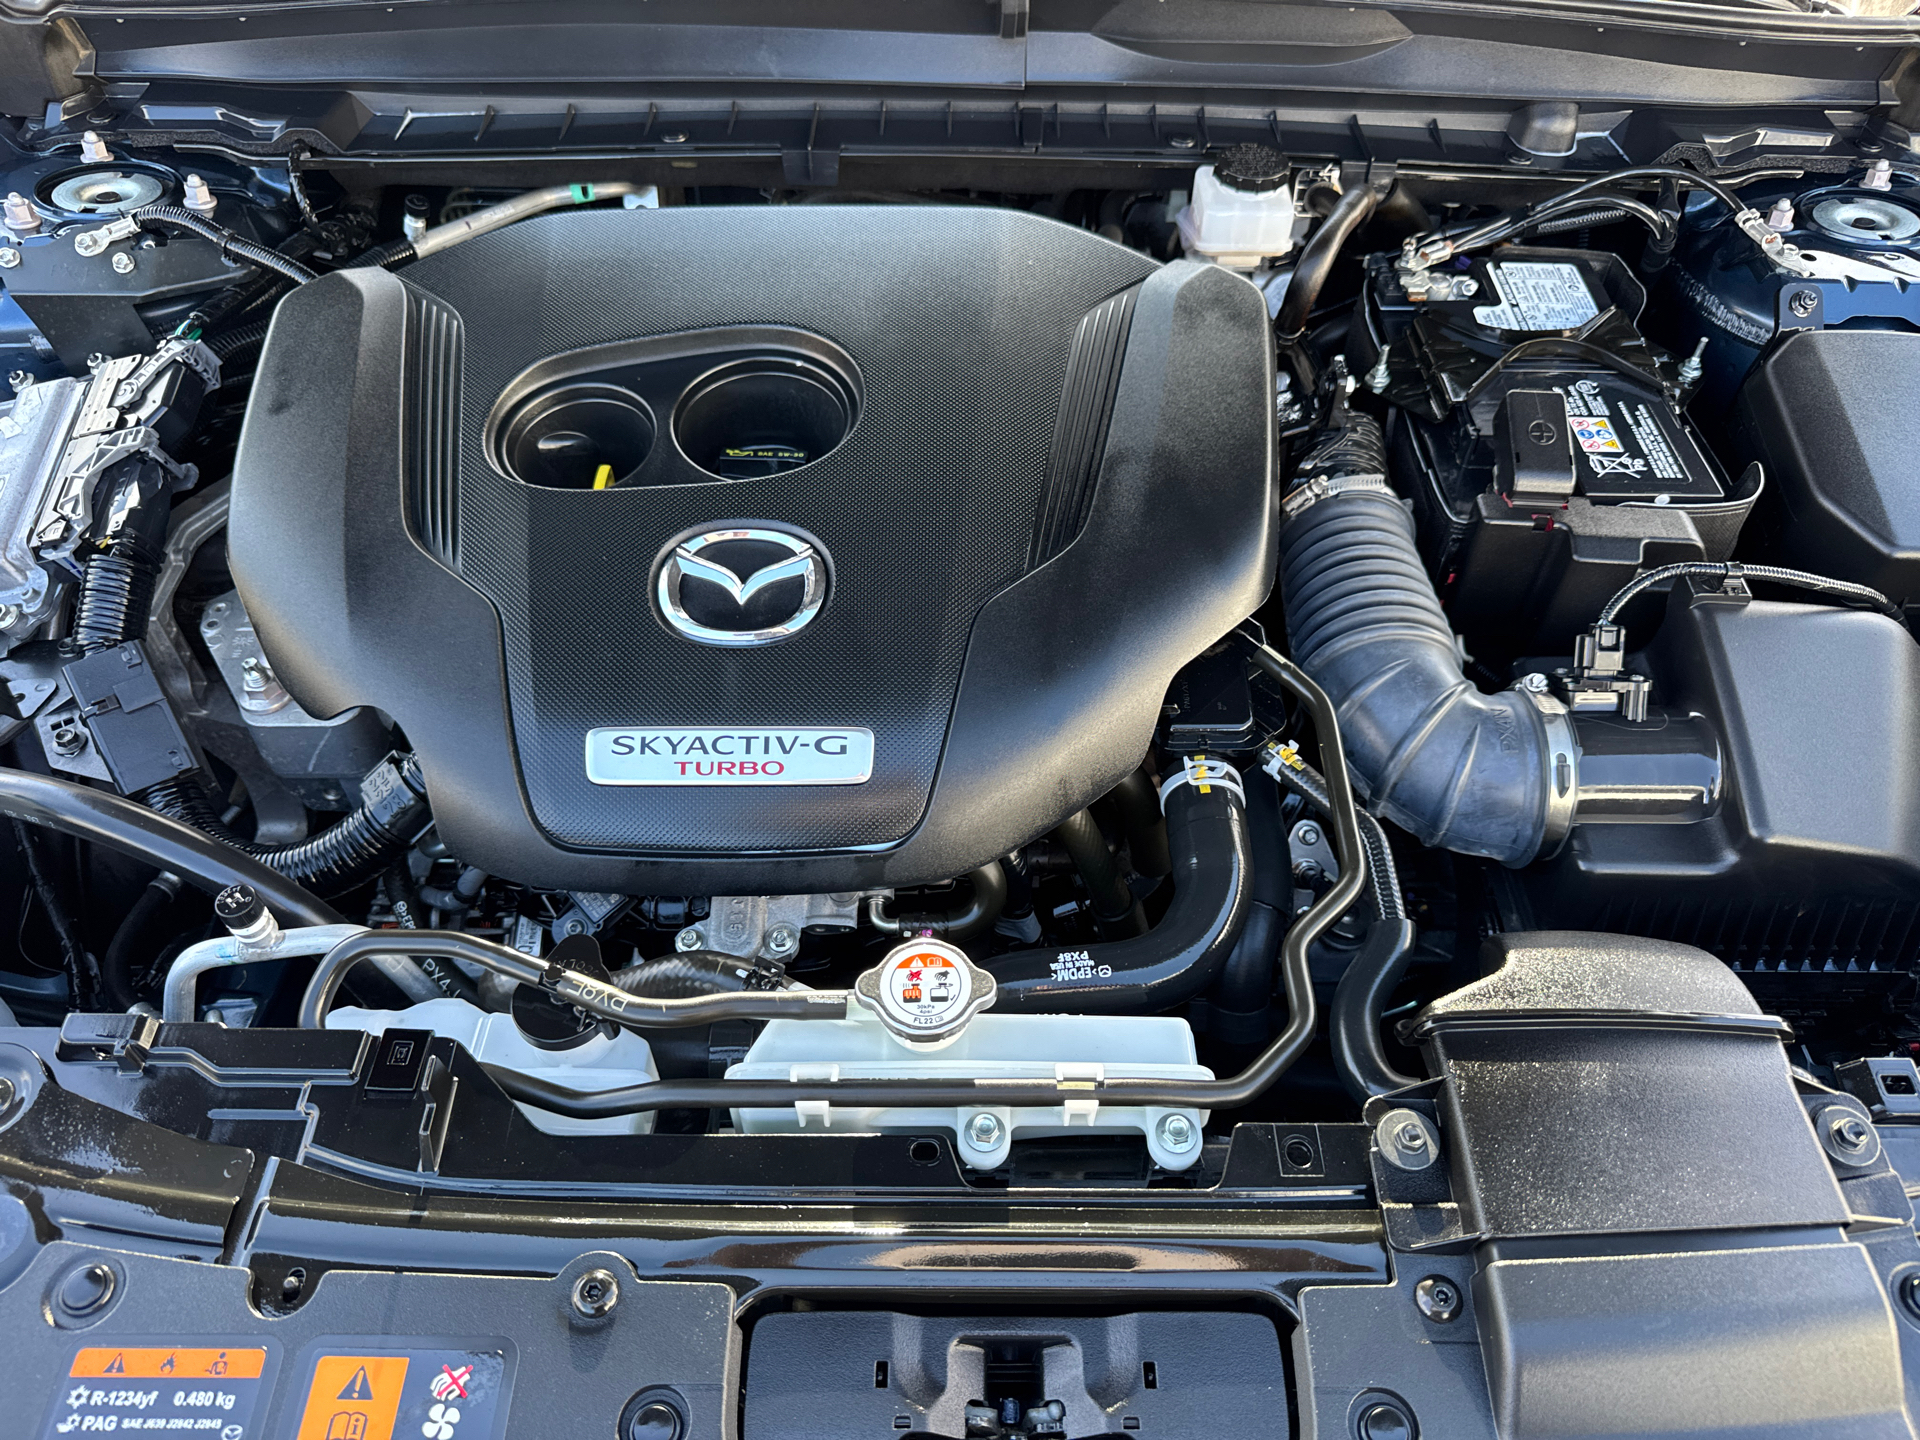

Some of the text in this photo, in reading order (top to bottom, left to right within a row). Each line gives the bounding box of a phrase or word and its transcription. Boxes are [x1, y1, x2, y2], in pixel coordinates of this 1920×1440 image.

[611, 735, 849, 755] SKYACTIV-G
[674, 761, 785, 776] TURBO
[1057, 950, 1089, 962] PX8F
[1049, 959, 1095, 970] MADE IN USA
[913, 1017, 934, 1025] FL22
[89, 1390, 236, 1410] R-1234yf 0.480 kg
[81, 1415, 119, 1431] PAG
[121, 1418, 144, 1429] SAE
